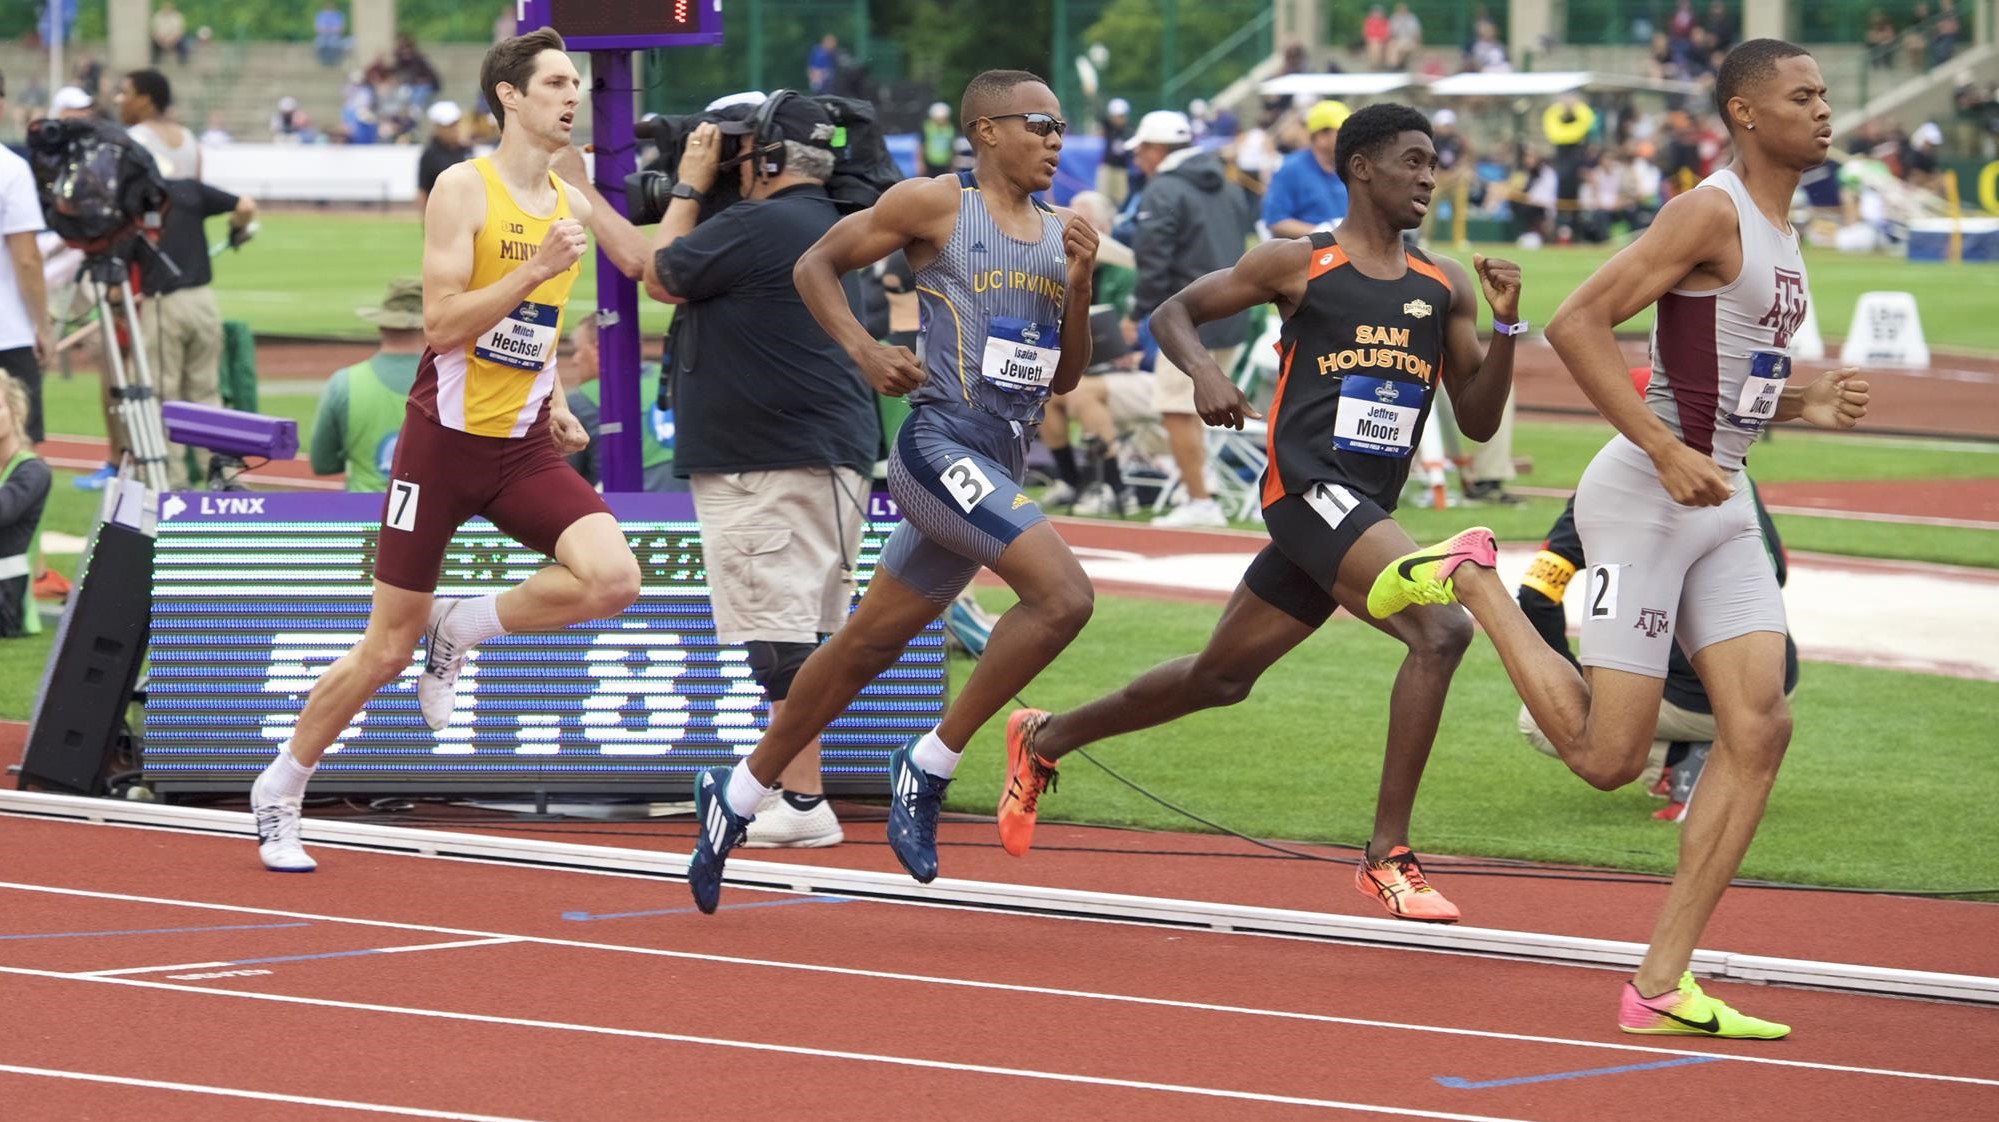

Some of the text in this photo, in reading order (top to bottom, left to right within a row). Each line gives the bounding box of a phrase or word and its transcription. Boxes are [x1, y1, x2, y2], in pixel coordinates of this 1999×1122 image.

[499, 240, 541, 261] MINN
[974, 270, 1066, 308] UC IRVINE
[512, 324, 535, 338] Mitch
[1355, 325, 1410, 348] SAM
[491, 332, 543, 358] Hechsel
[1014, 347, 1038, 361] Isaiah
[1000, 359, 1043, 382] Jewett
[1317, 348, 1432, 384] HOUSTON
[1367, 406, 1399, 423] Jeffrey
[1356, 418, 1400, 441] Moore
[948, 465, 983, 505] 3
[200, 497, 266, 515] LYNX
[395, 483, 412, 525] 7
[871, 497, 898, 516] LY
[1316, 483, 1350, 515] 1
[1592, 567, 1610, 617] 2
